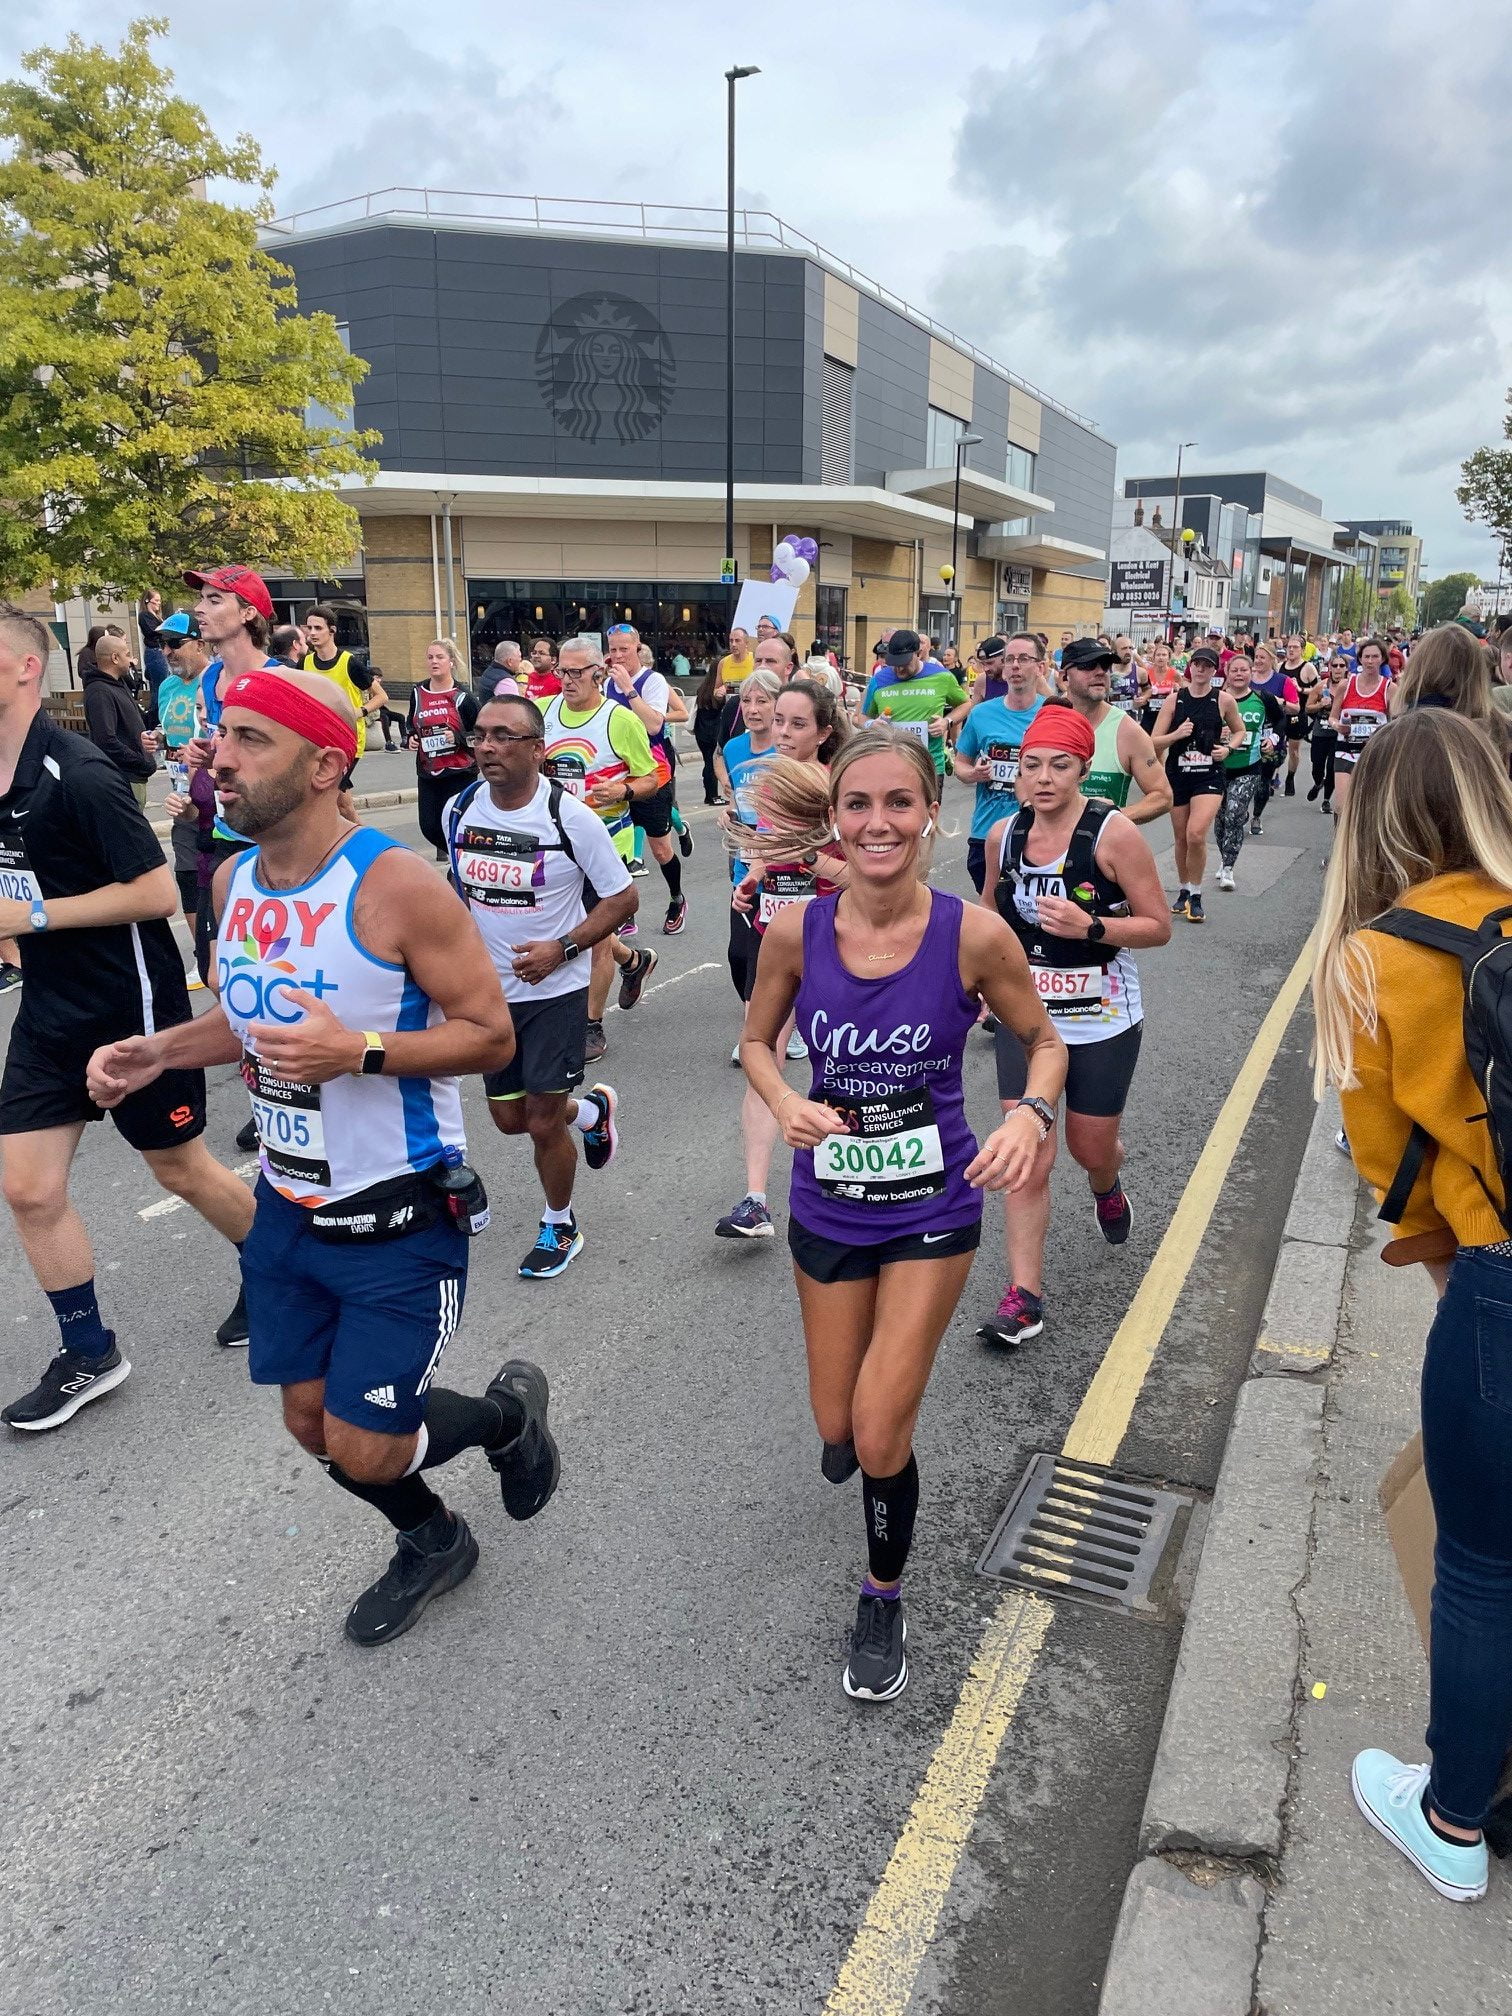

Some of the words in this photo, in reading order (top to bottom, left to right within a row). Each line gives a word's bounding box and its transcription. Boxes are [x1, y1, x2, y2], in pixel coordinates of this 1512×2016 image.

[901, 688, 936, 696] OXFAM
[418, 707, 448, 719] coram
[1238, 711, 1260, 723] CC
[992, 764, 1020, 778] 187
[495, 834, 512, 843] TATA
[465, 858, 522, 887] 46973
[486, 897, 500, 905] new
[500, 897, 529, 906] balance
[225, 898, 337, 947] ROY
[1048, 1007, 1063, 1015] new
[811, 1009, 932, 1058] Cruse
[823, 1055, 952, 1078] Bereavement
[258, 1075, 312, 1094] CONSULTANCY
[259, 1085, 293, 1100] SERVICES
[860, 1103, 889, 1114] TATA
[862, 1102, 924, 1123] CONSULTANCY
[863, 1118, 904, 1133] SERVICES
[828, 1137, 926, 1173] 30042
[866, 1193, 889, 1202] new
[890, 1185, 935, 1201] balance
[313, 1214, 337, 1227] LONDON
[337, 1213, 377, 1227] MARATHON
[350, 1223, 375, 1234] EVENTS
[363, 1392, 398, 1409] adidas
